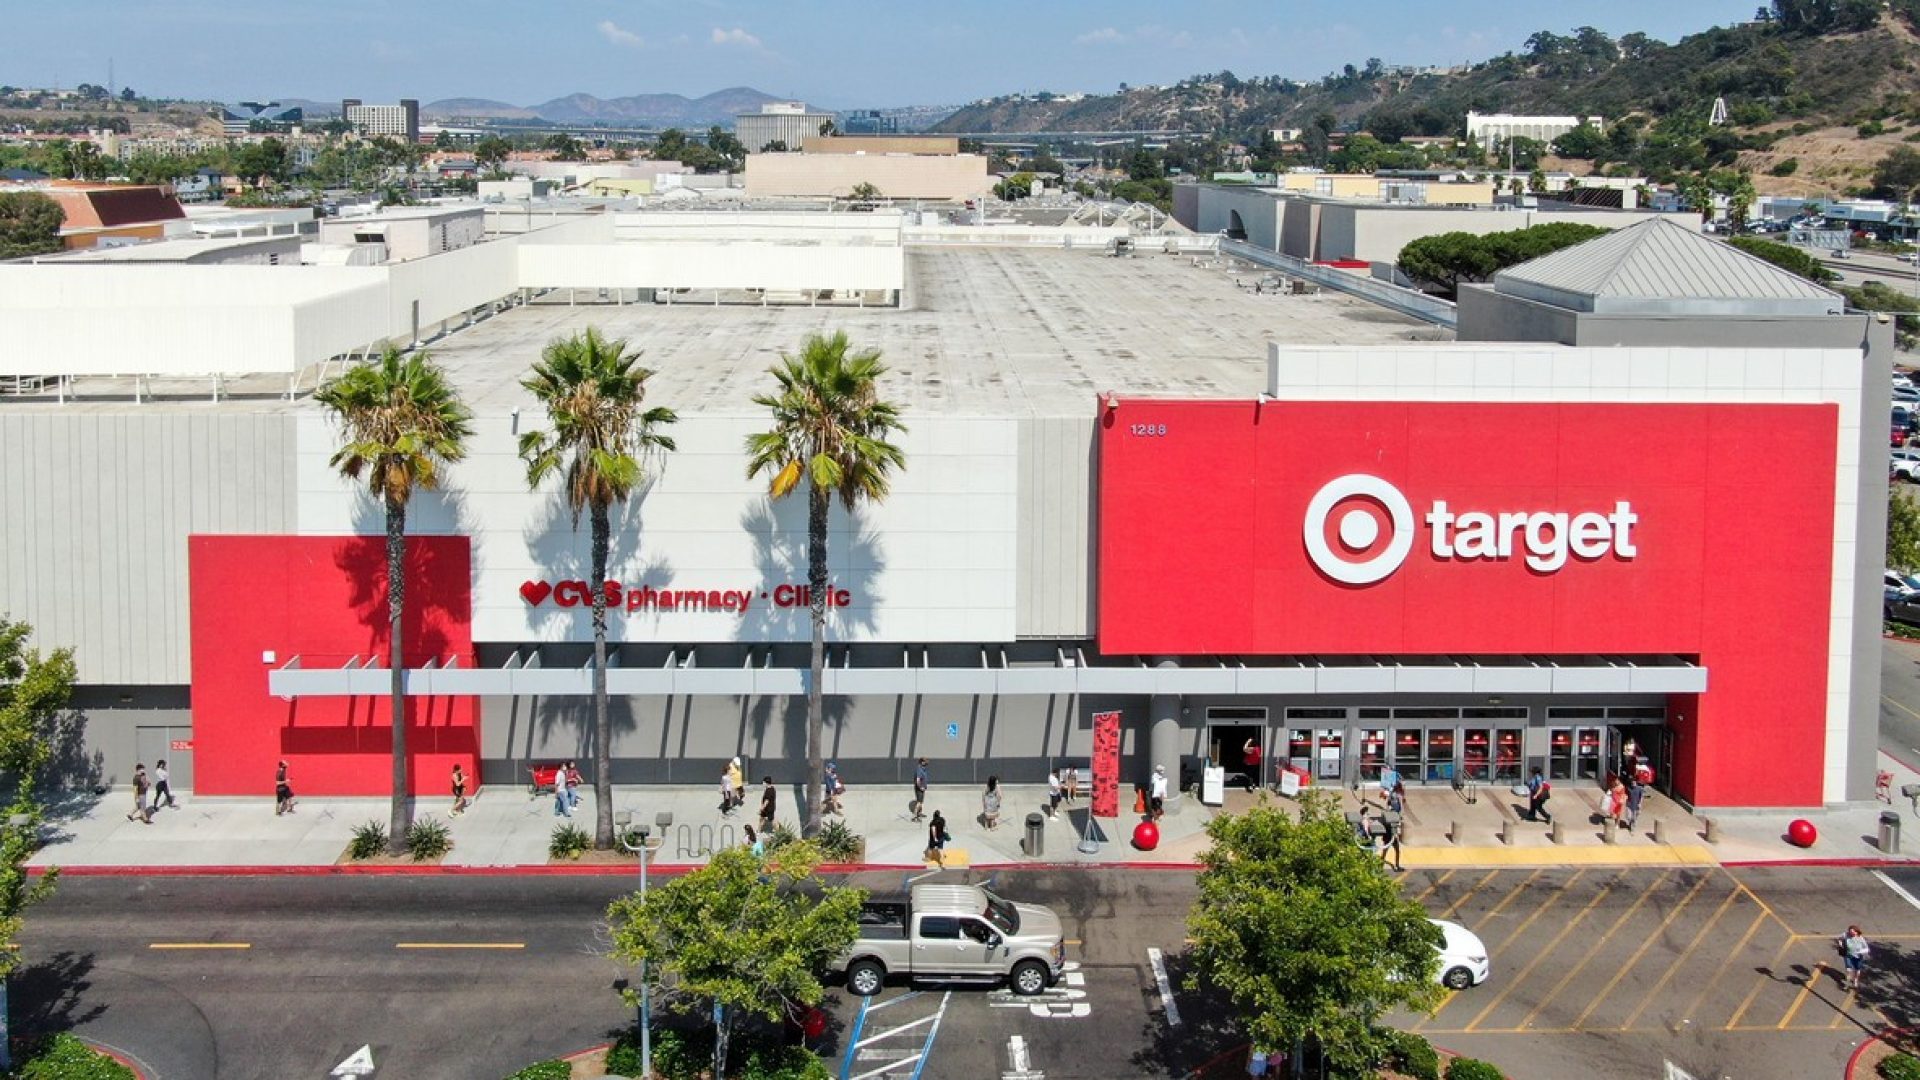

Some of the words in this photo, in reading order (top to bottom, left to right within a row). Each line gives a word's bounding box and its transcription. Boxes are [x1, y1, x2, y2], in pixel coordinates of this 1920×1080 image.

[1131, 424, 1166, 436] 1288
[1425, 500, 1638, 571] target
[626, 585, 751, 613] pharmacy
[774, 584, 850, 607] Cliic
